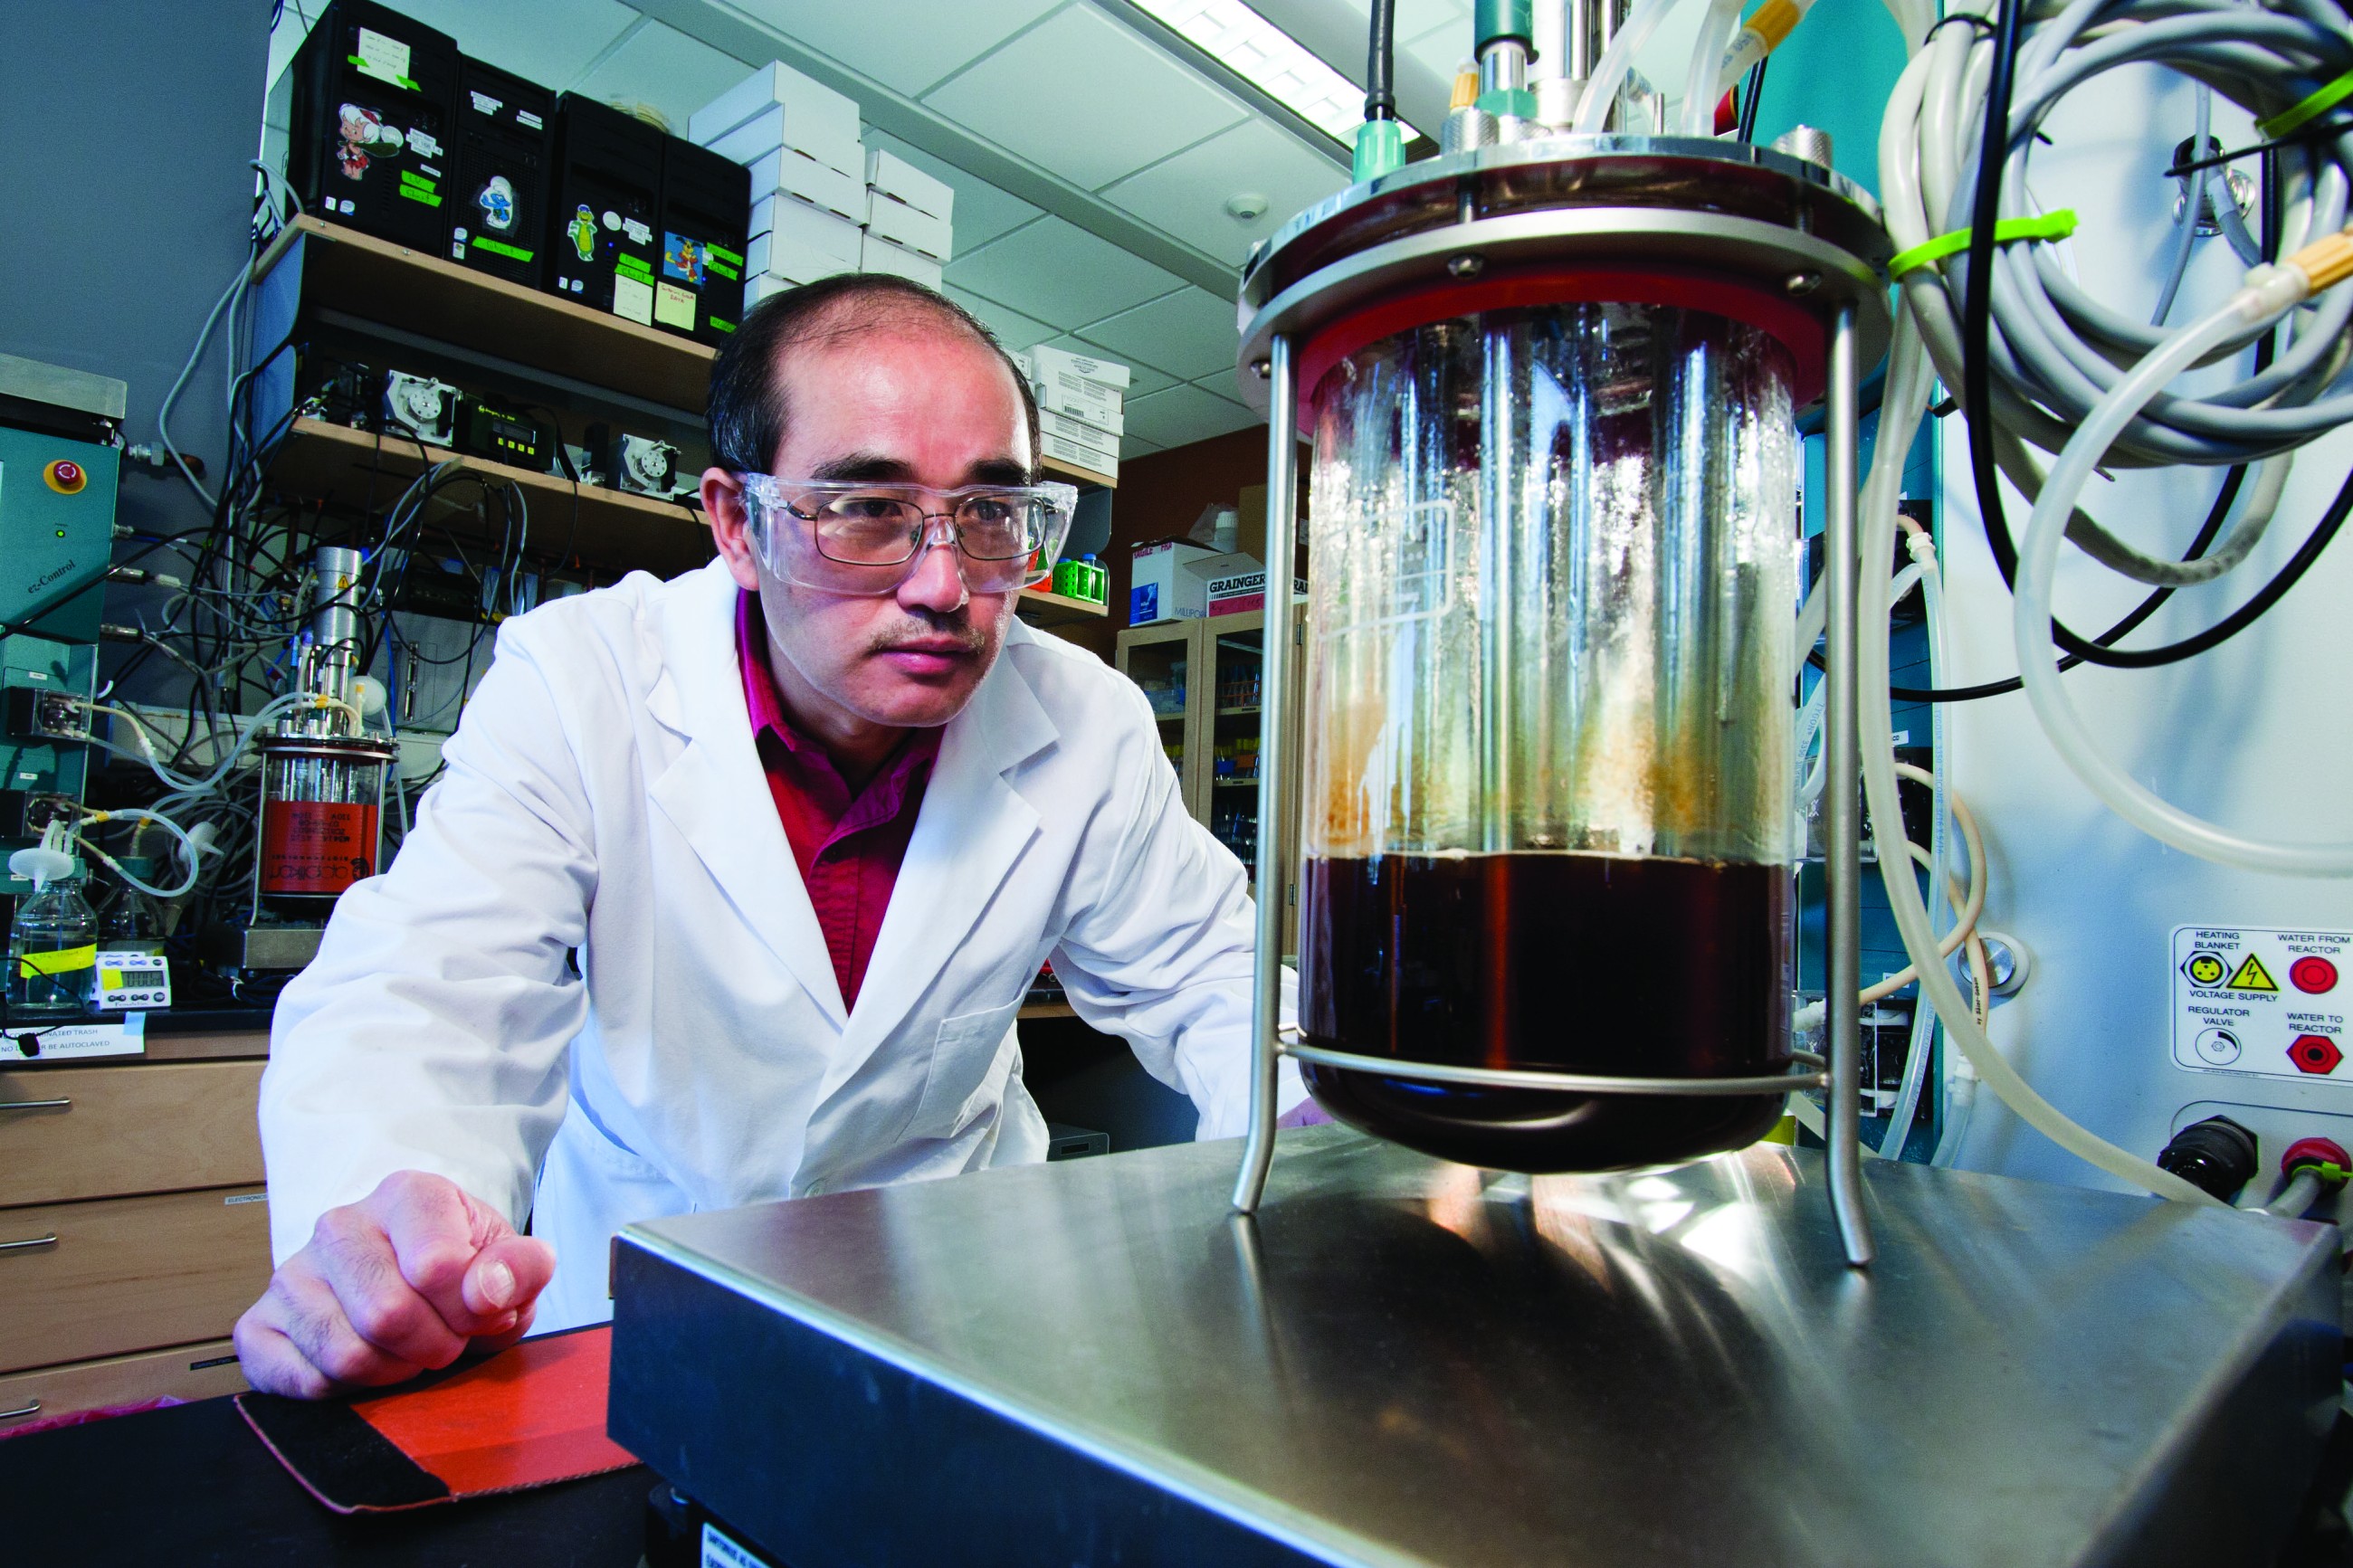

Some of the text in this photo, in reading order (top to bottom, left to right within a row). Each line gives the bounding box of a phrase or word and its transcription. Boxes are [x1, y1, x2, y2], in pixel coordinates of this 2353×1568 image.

[28, 559, 76, 594] ez-Control
[1209, 573, 1266, 594] GRAINGER
[2196, 931, 2240, 940] HEATING
[2277, 934, 2350, 944] WATER FROM
[2195, 941, 2241, 950] BLANKET
[2288, 945, 2340, 955] REACTOR
[2189, 990, 2278, 1003] VOLTAGE SUPPLY
[2187, 1005, 2251, 1017] REGULATOR
[2203, 1017, 2234, 1027] VALVE
[2286, 1012, 2344, 1023] WATER TO
[2289, 1023, 2342, 1034] REACTOR
[60, 1041, 110, 1050] AUTOCLAVED
